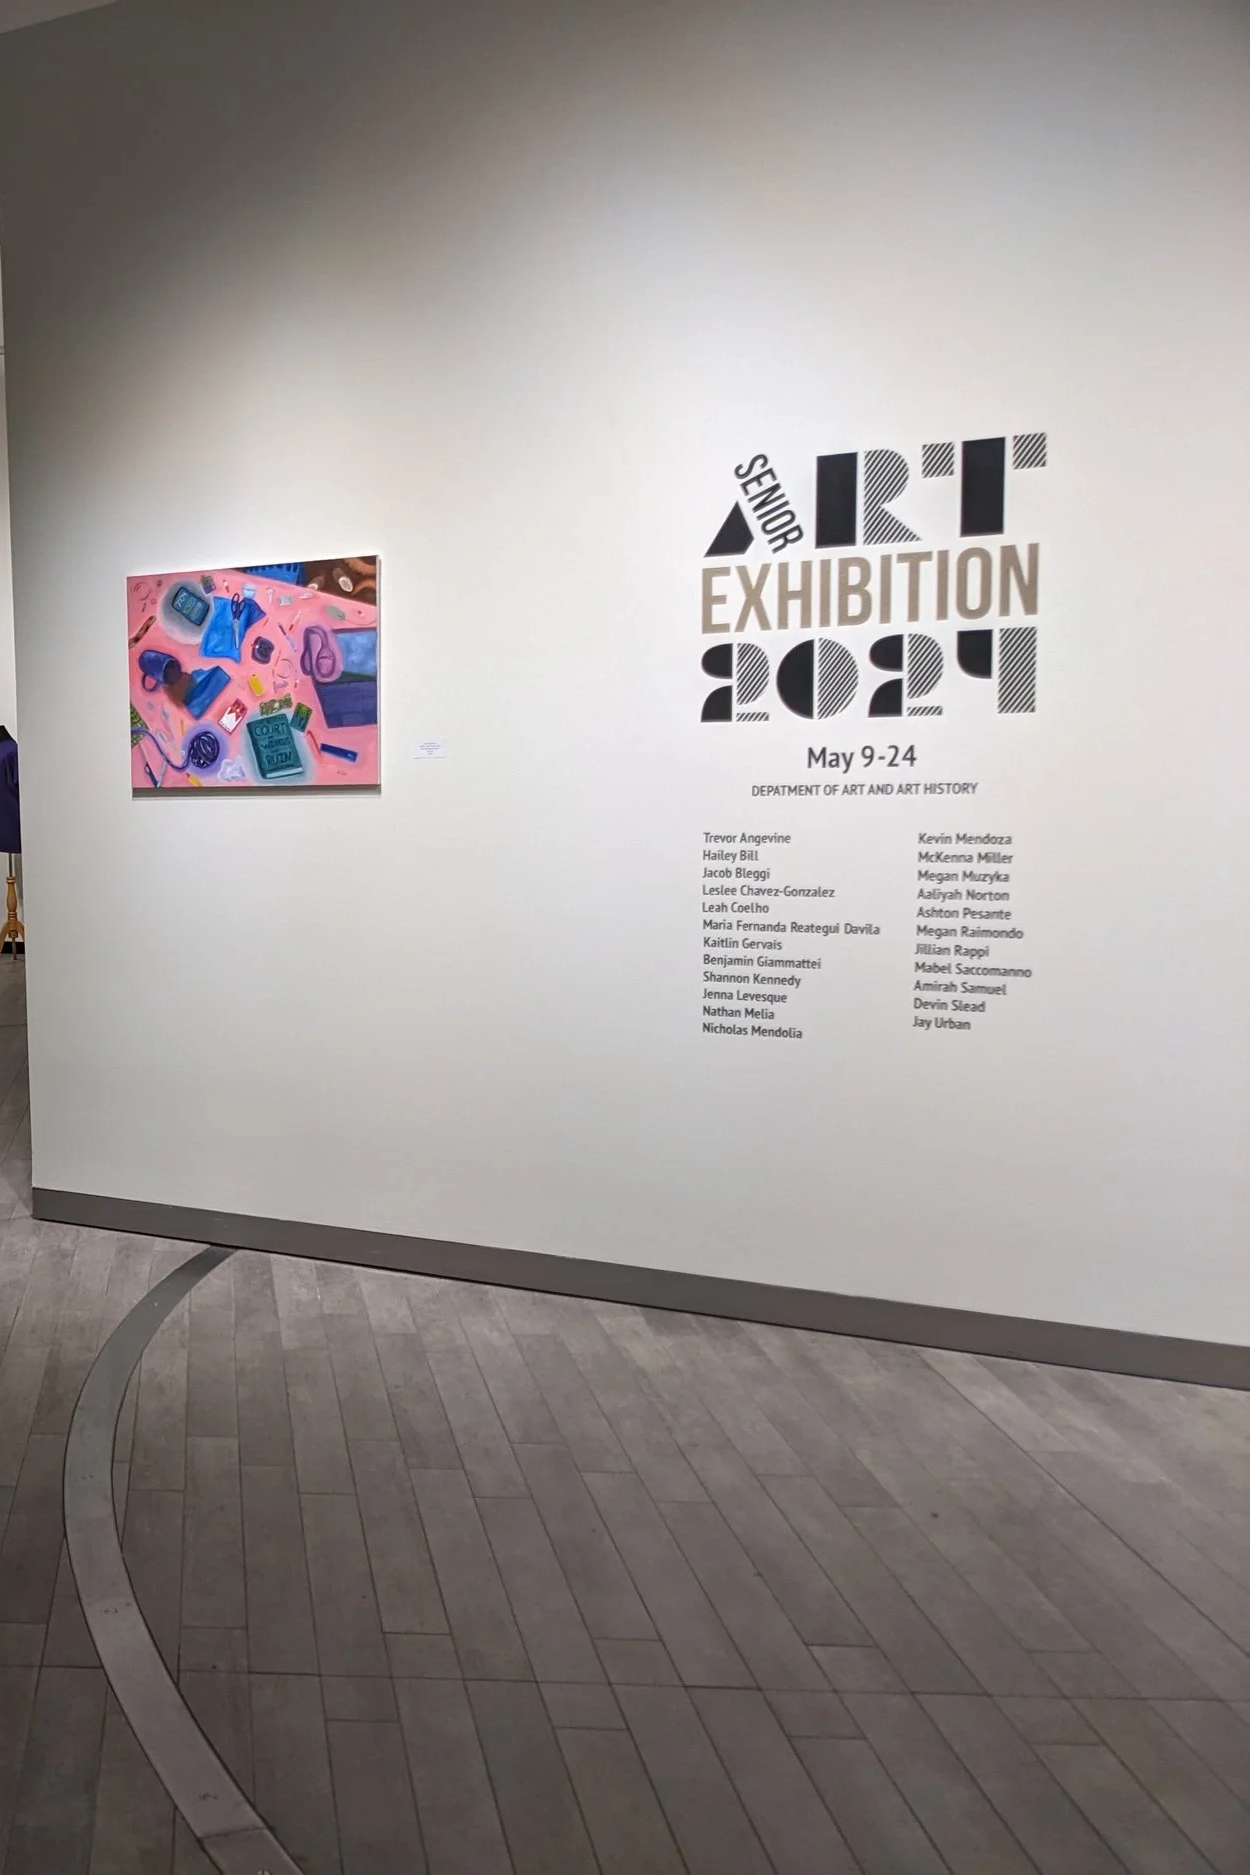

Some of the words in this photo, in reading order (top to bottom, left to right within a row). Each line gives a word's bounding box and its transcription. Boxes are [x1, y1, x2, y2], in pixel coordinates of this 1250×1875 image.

[703, 432, 1047, 557] ART
[733, 453, 805, 554] SENIOR
[701, 542, 1040, 635] EXHIBITION
[700, 626, 1038, 723] 2024
[254, 722, 286, 737] COURT
[807, 747, 855, 774] May
[861, 745, 917, 768] 9-24
[752, 785, 821, 796] DEPATMENT
[823, 784, 840, 796] OF
[841, 784, 866, 795] ART
[867, 784, 894, 795] AND
[896, 783, 921, 795] ART
[923, 783, 978, 794] HISTORY
[703, 832, 737, 843] Trevor
[739, 832, 791, 846] Angevine
[918, 833, 952, 844] Kevin
[955, 833, 1012, 845] Mendoza
[703, 850, 738, 864] Hailey
[740, 850, 758, 861] Bill
[918, 851, 974, 863] McKenna
[977, 852, 1014, 864] Miller
[702, 867, 732, 878] Jacob
[735, 867, 770, 882] Bleggi
[918, 870, 959, 884] Megan
[962, 870, 1010, 885] Muzyka
[703, 884, 737, 896] Leslee
[740, 885, 835, 897] Chavez-Gonzalez
[917, 888, 963, 903] Aaliyah
[966, 889, 1010, 901] Norton
[702, 902, 728, 913] Leah
[730, 902, 769, 913] Coelho
[916, 906, 959, 918] Ashton
[962, 907, 1012, 920] Pesante
[703, 919, 733, 930] Maria
[736, 920, 787, 932] Fernanda
[790, 921, 840, 936] Reategui
[844, 923, 880, 935] Davila
[916, 925, 957, 940] Megan
[961, 926, 1024, 939] Raimondo
[704, 937, 739, 948] Kaitlin
[742, 938, 782, 950] Gervais
[954, 945, 989, 960] Rappi
[703, 954, 754, 968] Benjamin
[757, 956, 821, 969] Giammattei
[915, 961, 952, 974] Mabel
[703, 971, 750, 984] Shannon
[753, 973, 802, 989] Kennedy
[913, 980, 958, 992] Amirah
[960, 982, 1006, 995] Samuel
[703, 988, 734, 1000] Jenna
[736, 990, 787, 1005] Levesque
[914, 997, 948, 1010] Devin
[951, 1000, 986, 1012] Slead
[703, 1005, 742, 1018] Nathan
[744, 1007, 775, 1020] Melia
[703, 1022, 748, 1035] Nicholas
[751, 1025, 802, 1039] Mendolia
[912, 1016, 932, 1030] Jay
[934, 1017, 971, 1030] Urban
